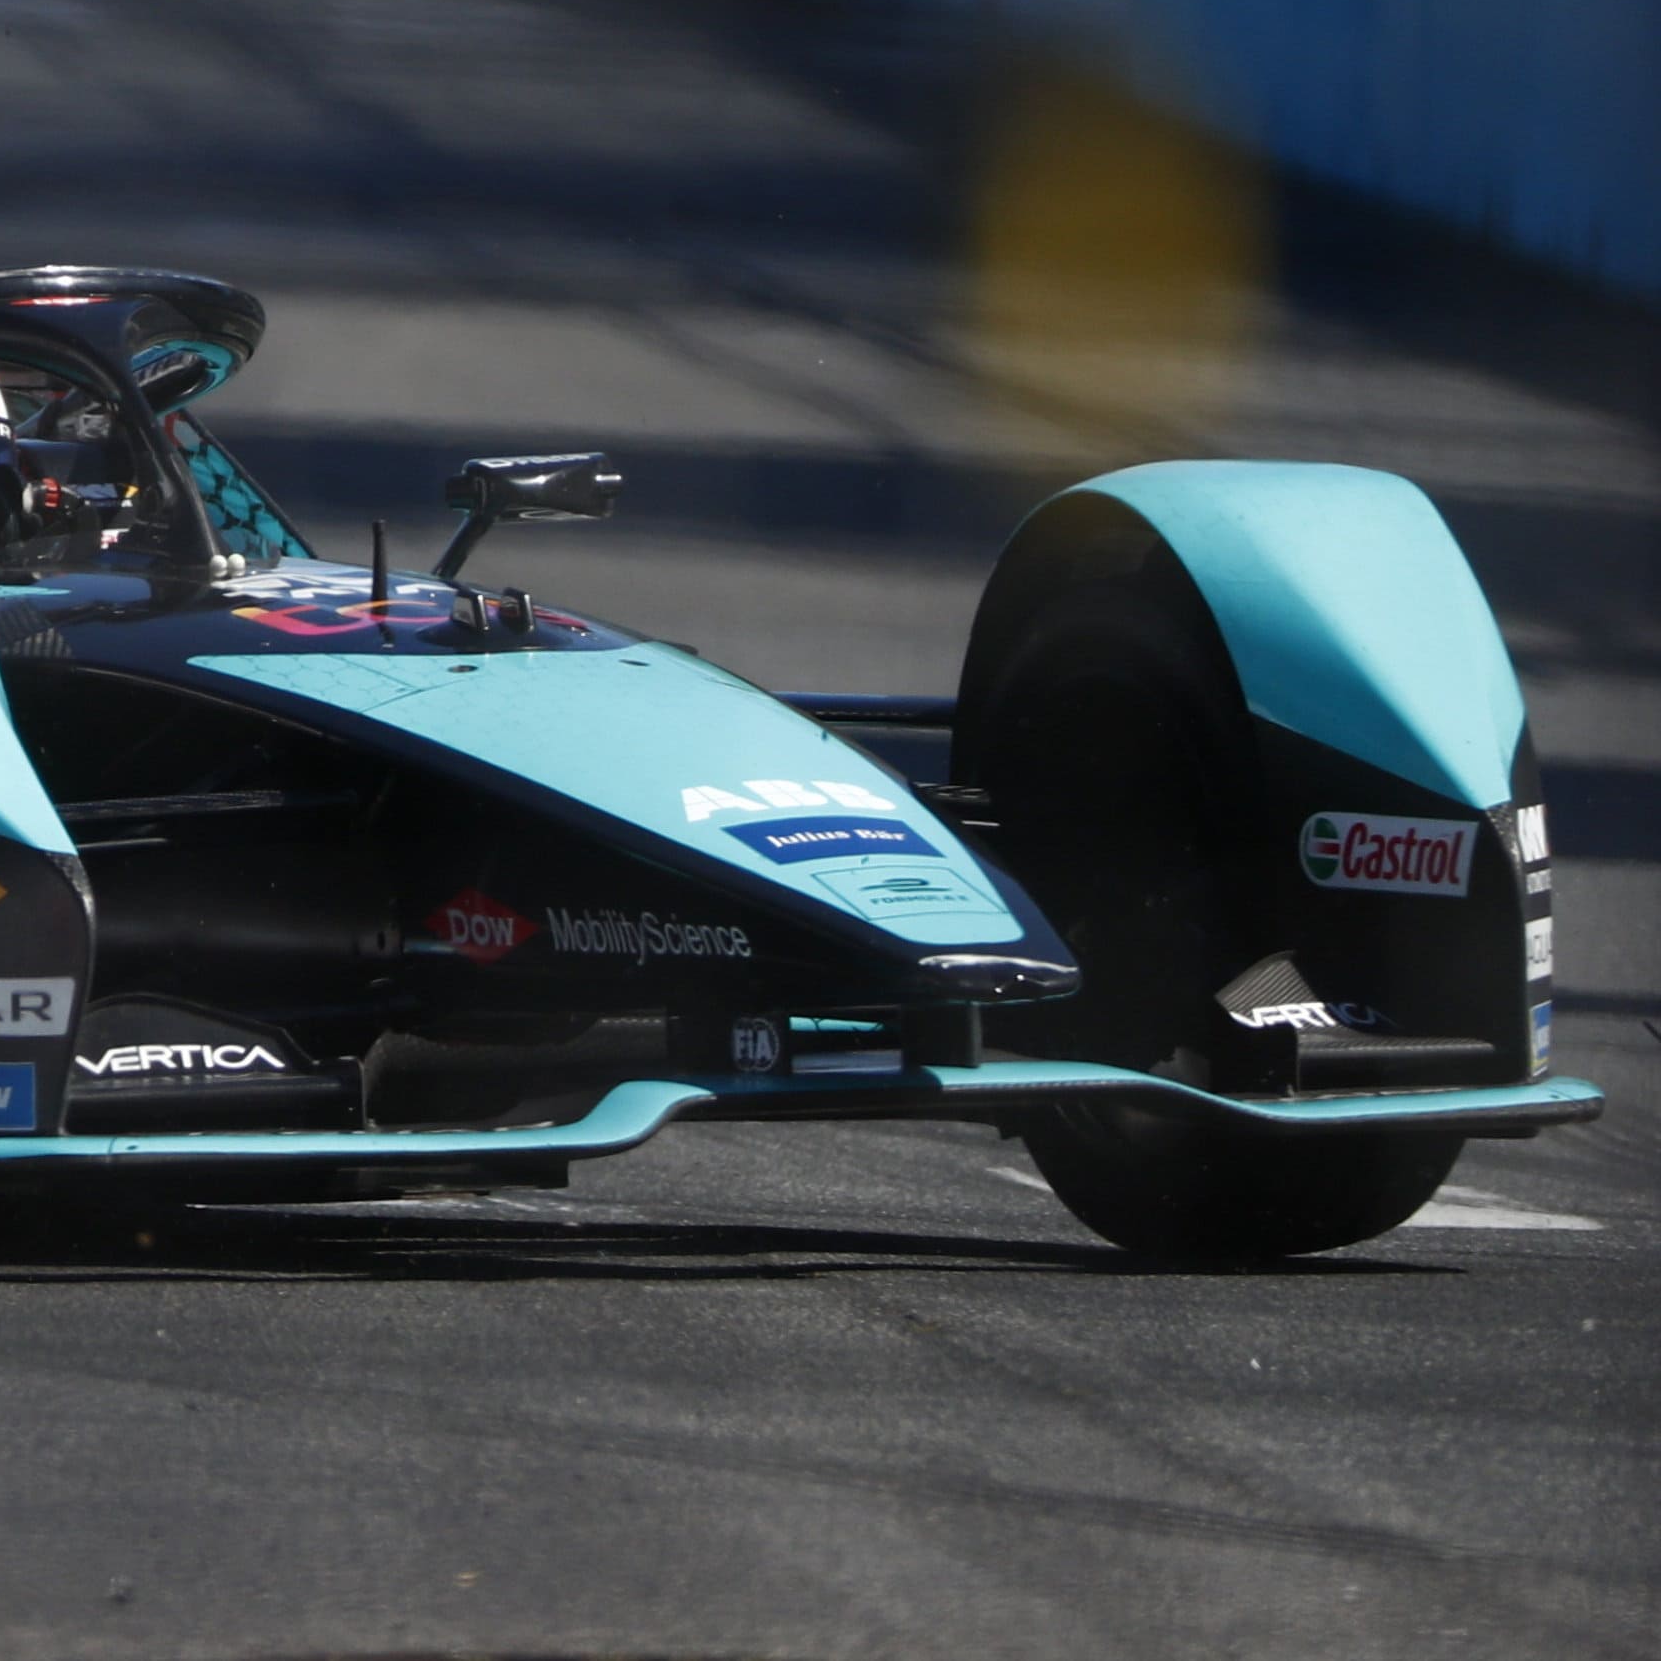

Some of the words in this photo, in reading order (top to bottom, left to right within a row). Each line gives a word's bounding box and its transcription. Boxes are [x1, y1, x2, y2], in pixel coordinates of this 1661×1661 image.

[681, 779, 897, 822] ABB
[767, 830, 851, 848] Julius
[1341, 822, 1462, 885] Castrol
[546, 907, 752, 965] MobilityScience
[76, 1044, 285, 1075] VERTICA
[734, 1029, 775, 1060] FIA
